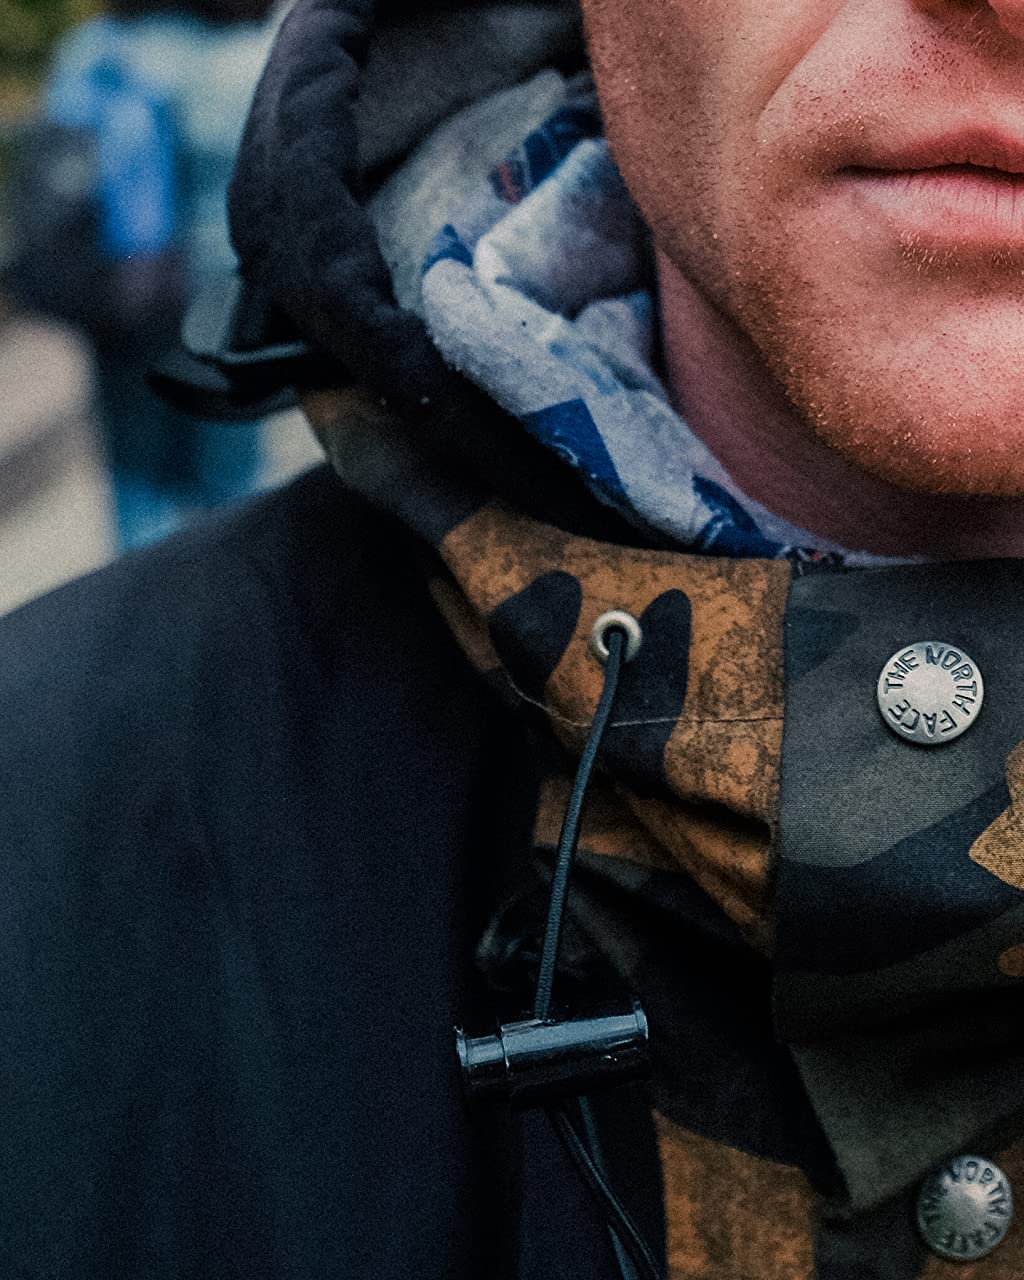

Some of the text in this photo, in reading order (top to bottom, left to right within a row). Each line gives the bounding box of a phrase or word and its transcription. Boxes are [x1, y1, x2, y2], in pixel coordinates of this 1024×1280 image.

[884, 645, 978, 737] THE NORTH FACE
